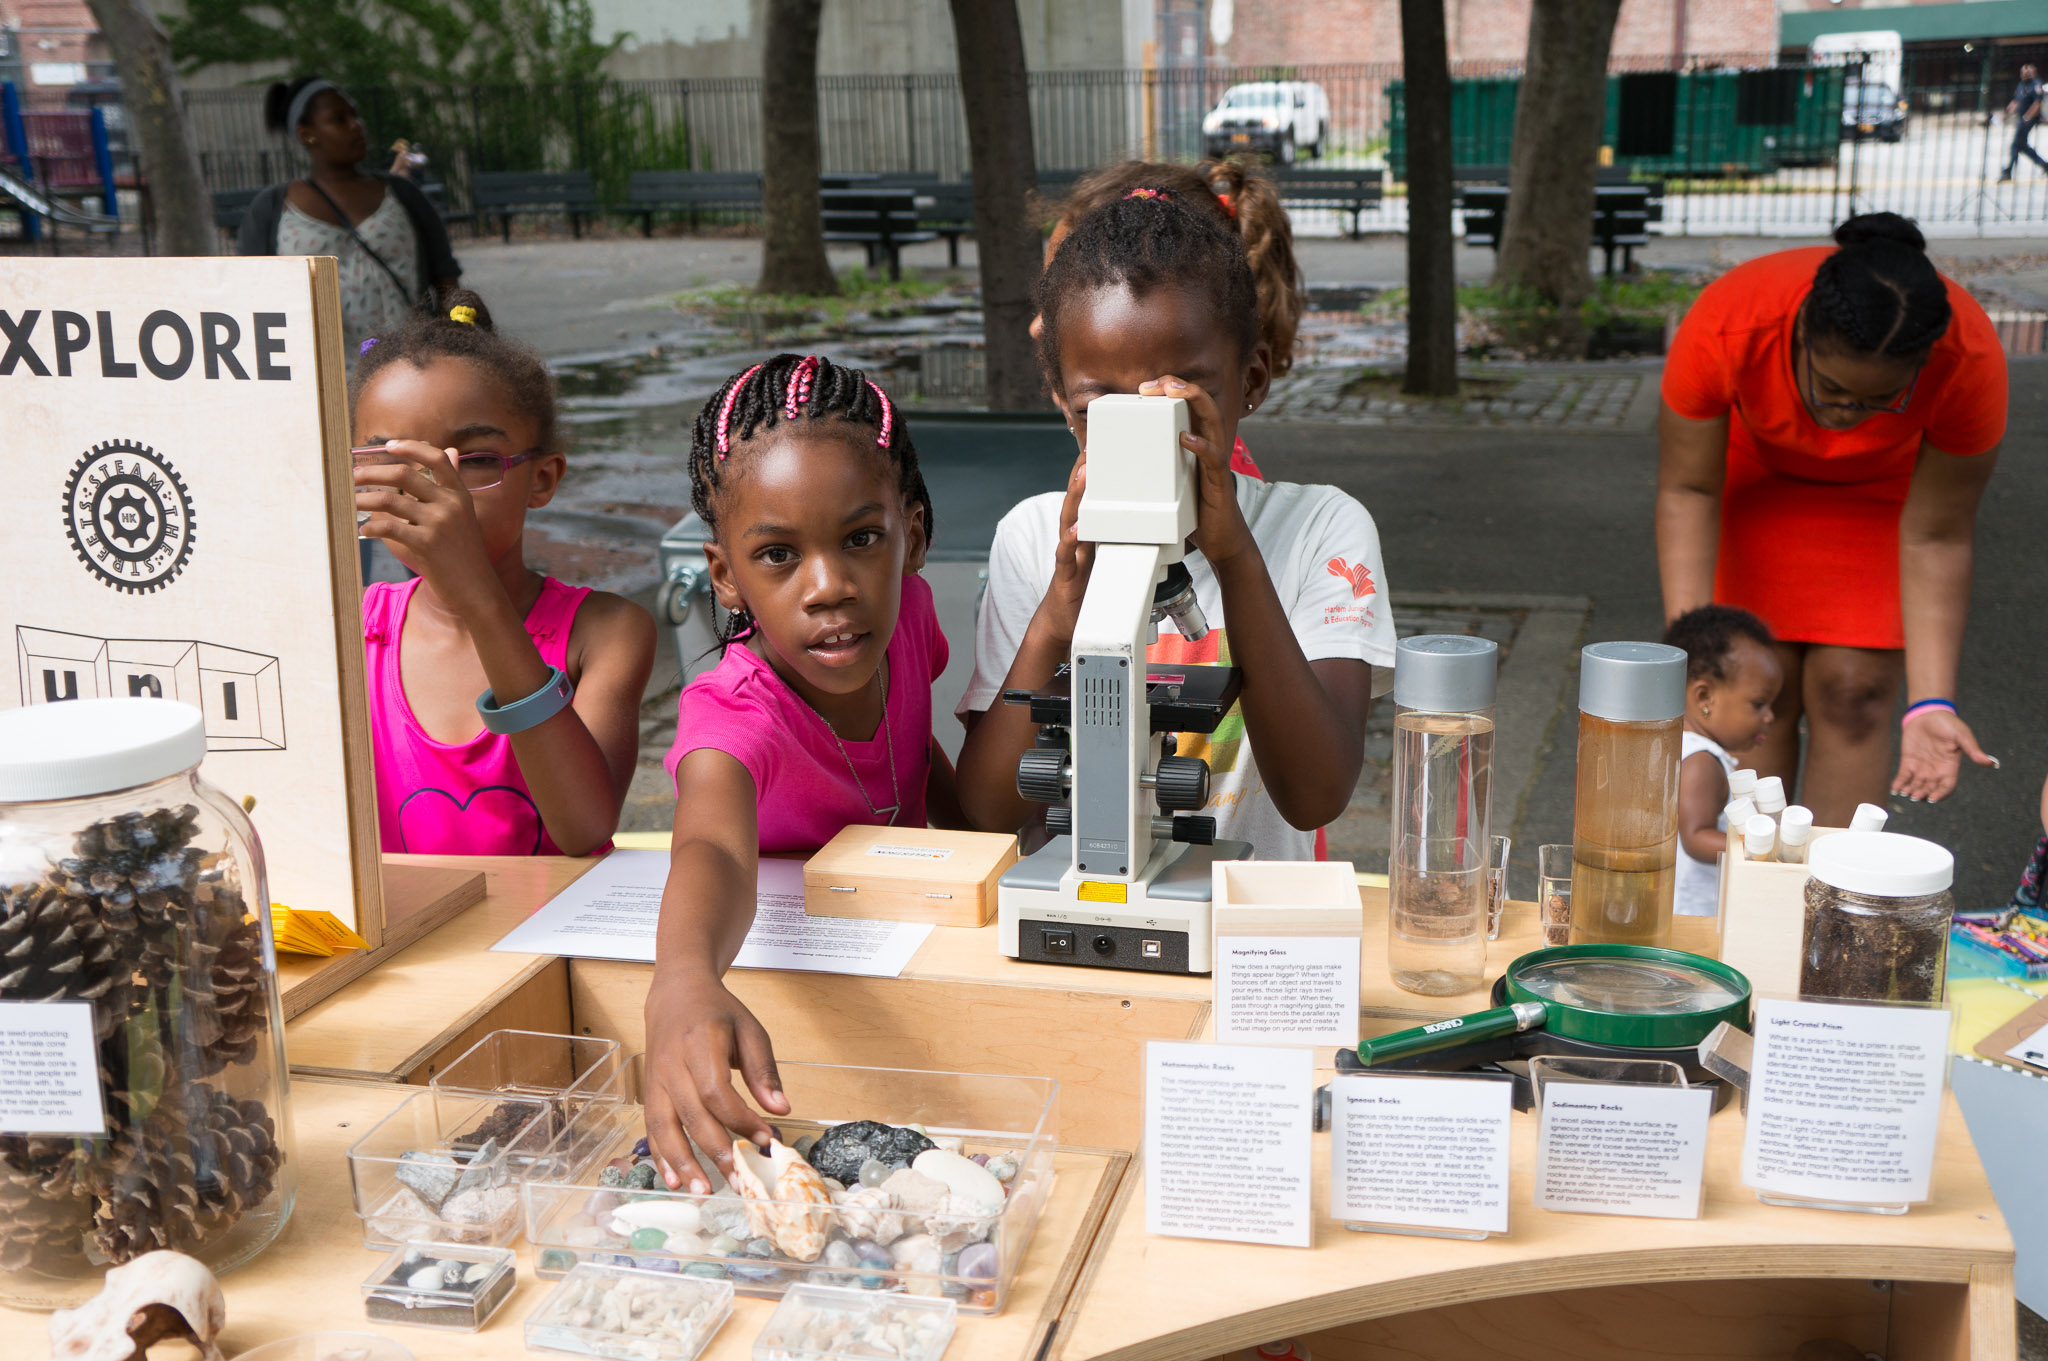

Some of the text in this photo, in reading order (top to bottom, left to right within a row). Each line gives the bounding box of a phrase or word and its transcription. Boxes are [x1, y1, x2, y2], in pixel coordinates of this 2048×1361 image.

[89, 460, 164, 492] STEAM
[121, 513, 138, 524] HK
[164, 505, 179, 556] THE
[79, 501, 155, 576] STREETS
[1324, 605, 1346, 614] Harlem
[1330, 615, 1360, 624] Education
[1270, 963, 1304, 972] magnifying
[1306, 963, 1322, 972] glass
[1231, 971, 1250, 979] things
[1276, 971, 1300, 979] bigger?
[1321, 971, 1335, 979] light
[1279, 979, 1298, 987] object
[1284, 987, 1298, 995] light
[1231, 994, 1254, 1003] parallel
[1319, 994, 1334, 1003] they
[1248, 1002, 1272, 1010] through
[1279, 1002, 1313, 1010] magnifying
[1302, 1010, 1325, 1018] parallel
[1253, 1017, 1268, 1026] they
[1422, 1018, 1464, 1034] CARSON
[1771, 1017, 1790, 1026] Light
[1252, 1025, 1271, 1033] image
[1161, 1061, 1235, 1071] Metamorphic Rocks
[1347, 1096, 1375, 1104] Igneous
[1552, 1101, 1598, 1111] Sedimentary
